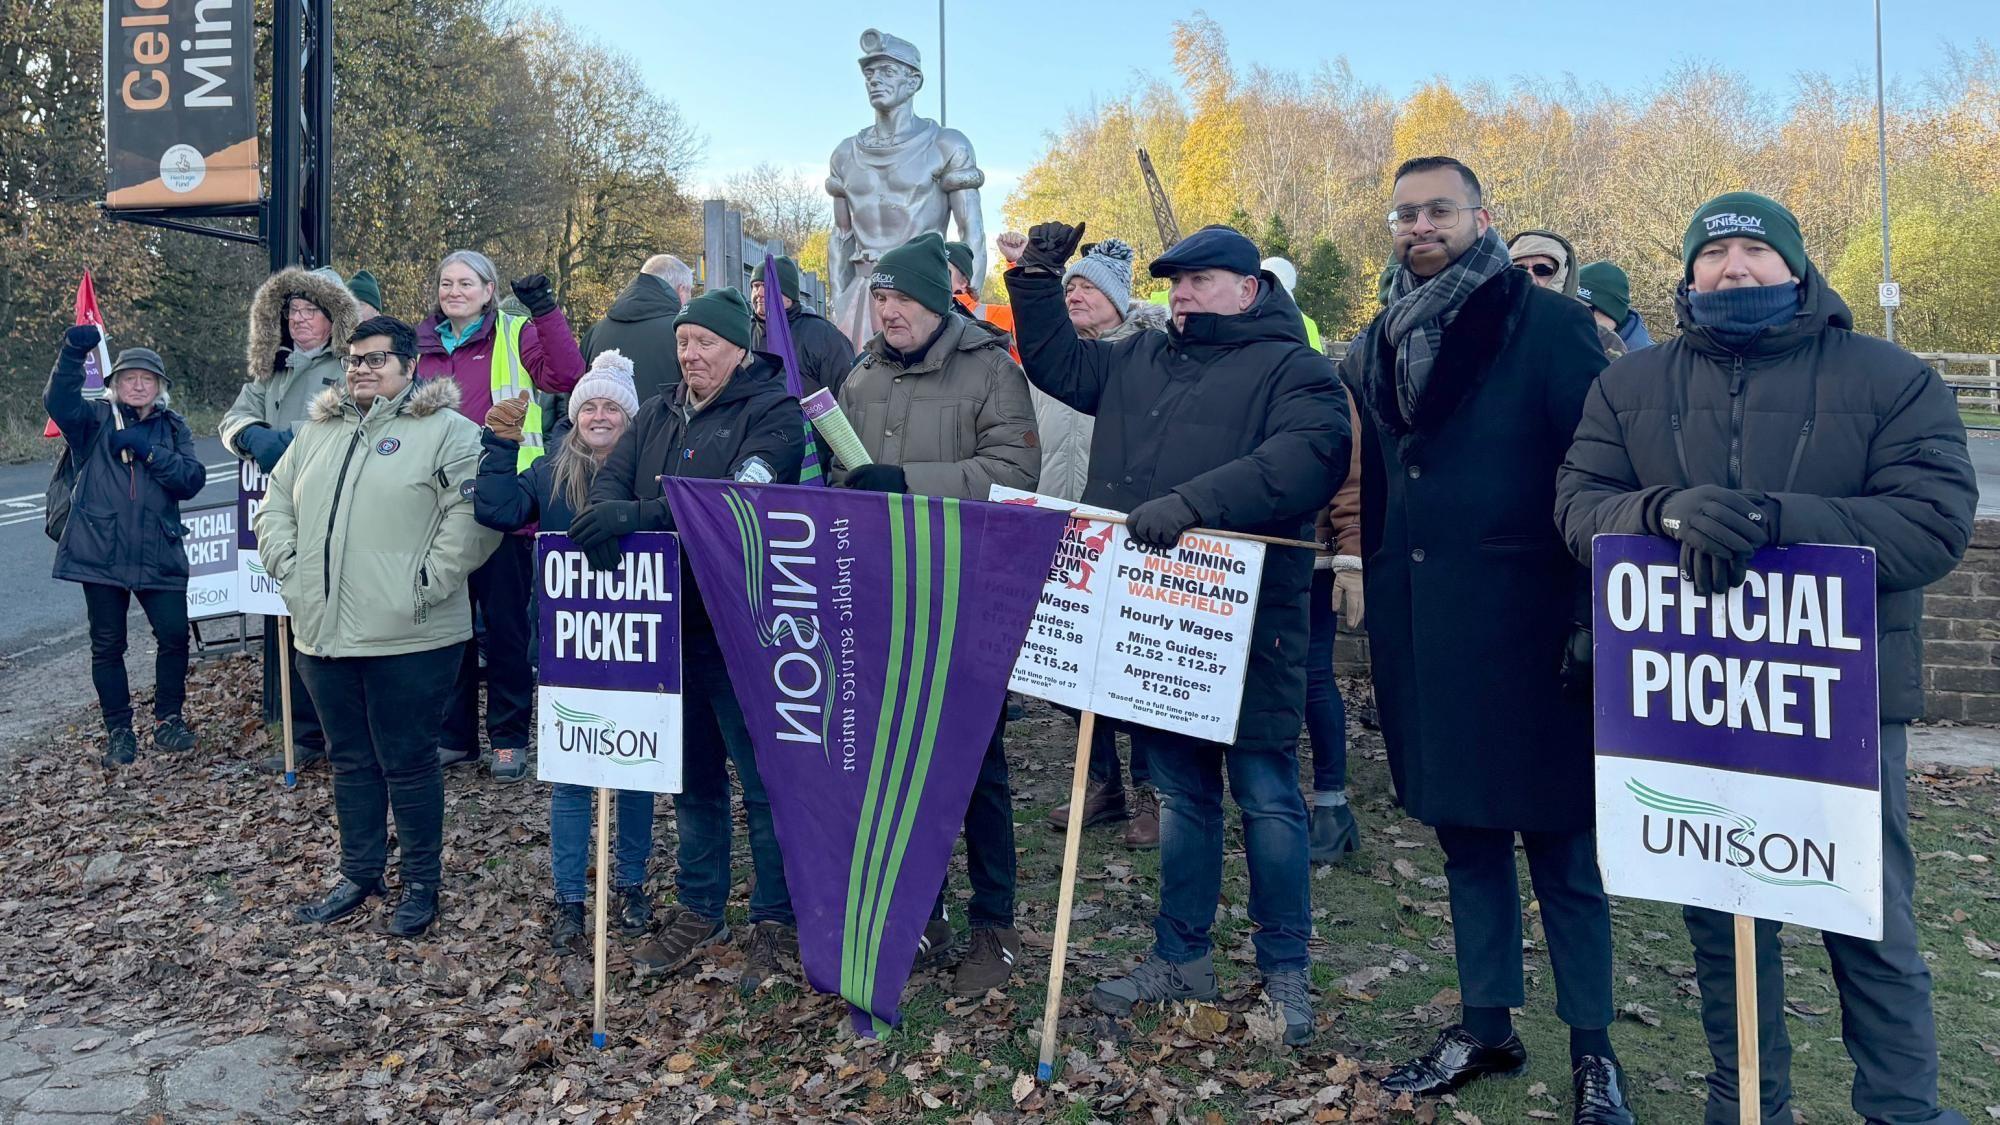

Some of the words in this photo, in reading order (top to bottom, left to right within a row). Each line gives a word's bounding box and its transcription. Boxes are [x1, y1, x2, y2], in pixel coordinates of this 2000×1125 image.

[121, 0, 170, 110] Cel
[1706, 215, 1762, 230] UNISON
[181, 512, 236, 540] FICIAL
[184, 538, 230, 566] CKET
[1057, 541, 1100, 562] NING
[1177, 549, 1246, 575] MINING
[1117, 564, 1155, 585] FOR
[1160, 574, 1249, 605] ENGLAND
[1143, 555, 1226, 586] MUSEUM
[186, 588, 228, 606] NISON
[1040, 592, 1090, 614] Wages
[1128, 581, 1234, 616] WAKEFIELD
[1033, 613, 1075, 630] uides:
[1038, 624, 1083, 645] £18.98
[1119, 605, 1174, 630] Hourly
[1179, 618, 1234, 642] Wages
[555, 610, 662, 663] PICKET
[1128, 631, 1161, 647] Mine
[1165, 640, 1217, 661] Guides:
[1033, 653, 1079, 674] £15.24
[1115, 641, 1164, 661] £12.52
[1178, 656, 1227, 676] £12.87
[1027, 671, 1043, 680] time
[1123, 664, 1212, 693] Apprentices:
[1142, 680, 1190, 700] £12.60
[1632, 649, 1841, 739] PICKET
[1133, 703, 1154, 714] hours
[1152, 702, 1165, 710] full
[1166, 705, 1183, 714] time
[1184, 710, 1199, 718] role
[1210, 715, 1221, 723] 37
[558, 725, 658, 758] UNISON
[1642, 814, 1836, 882] UNISON
